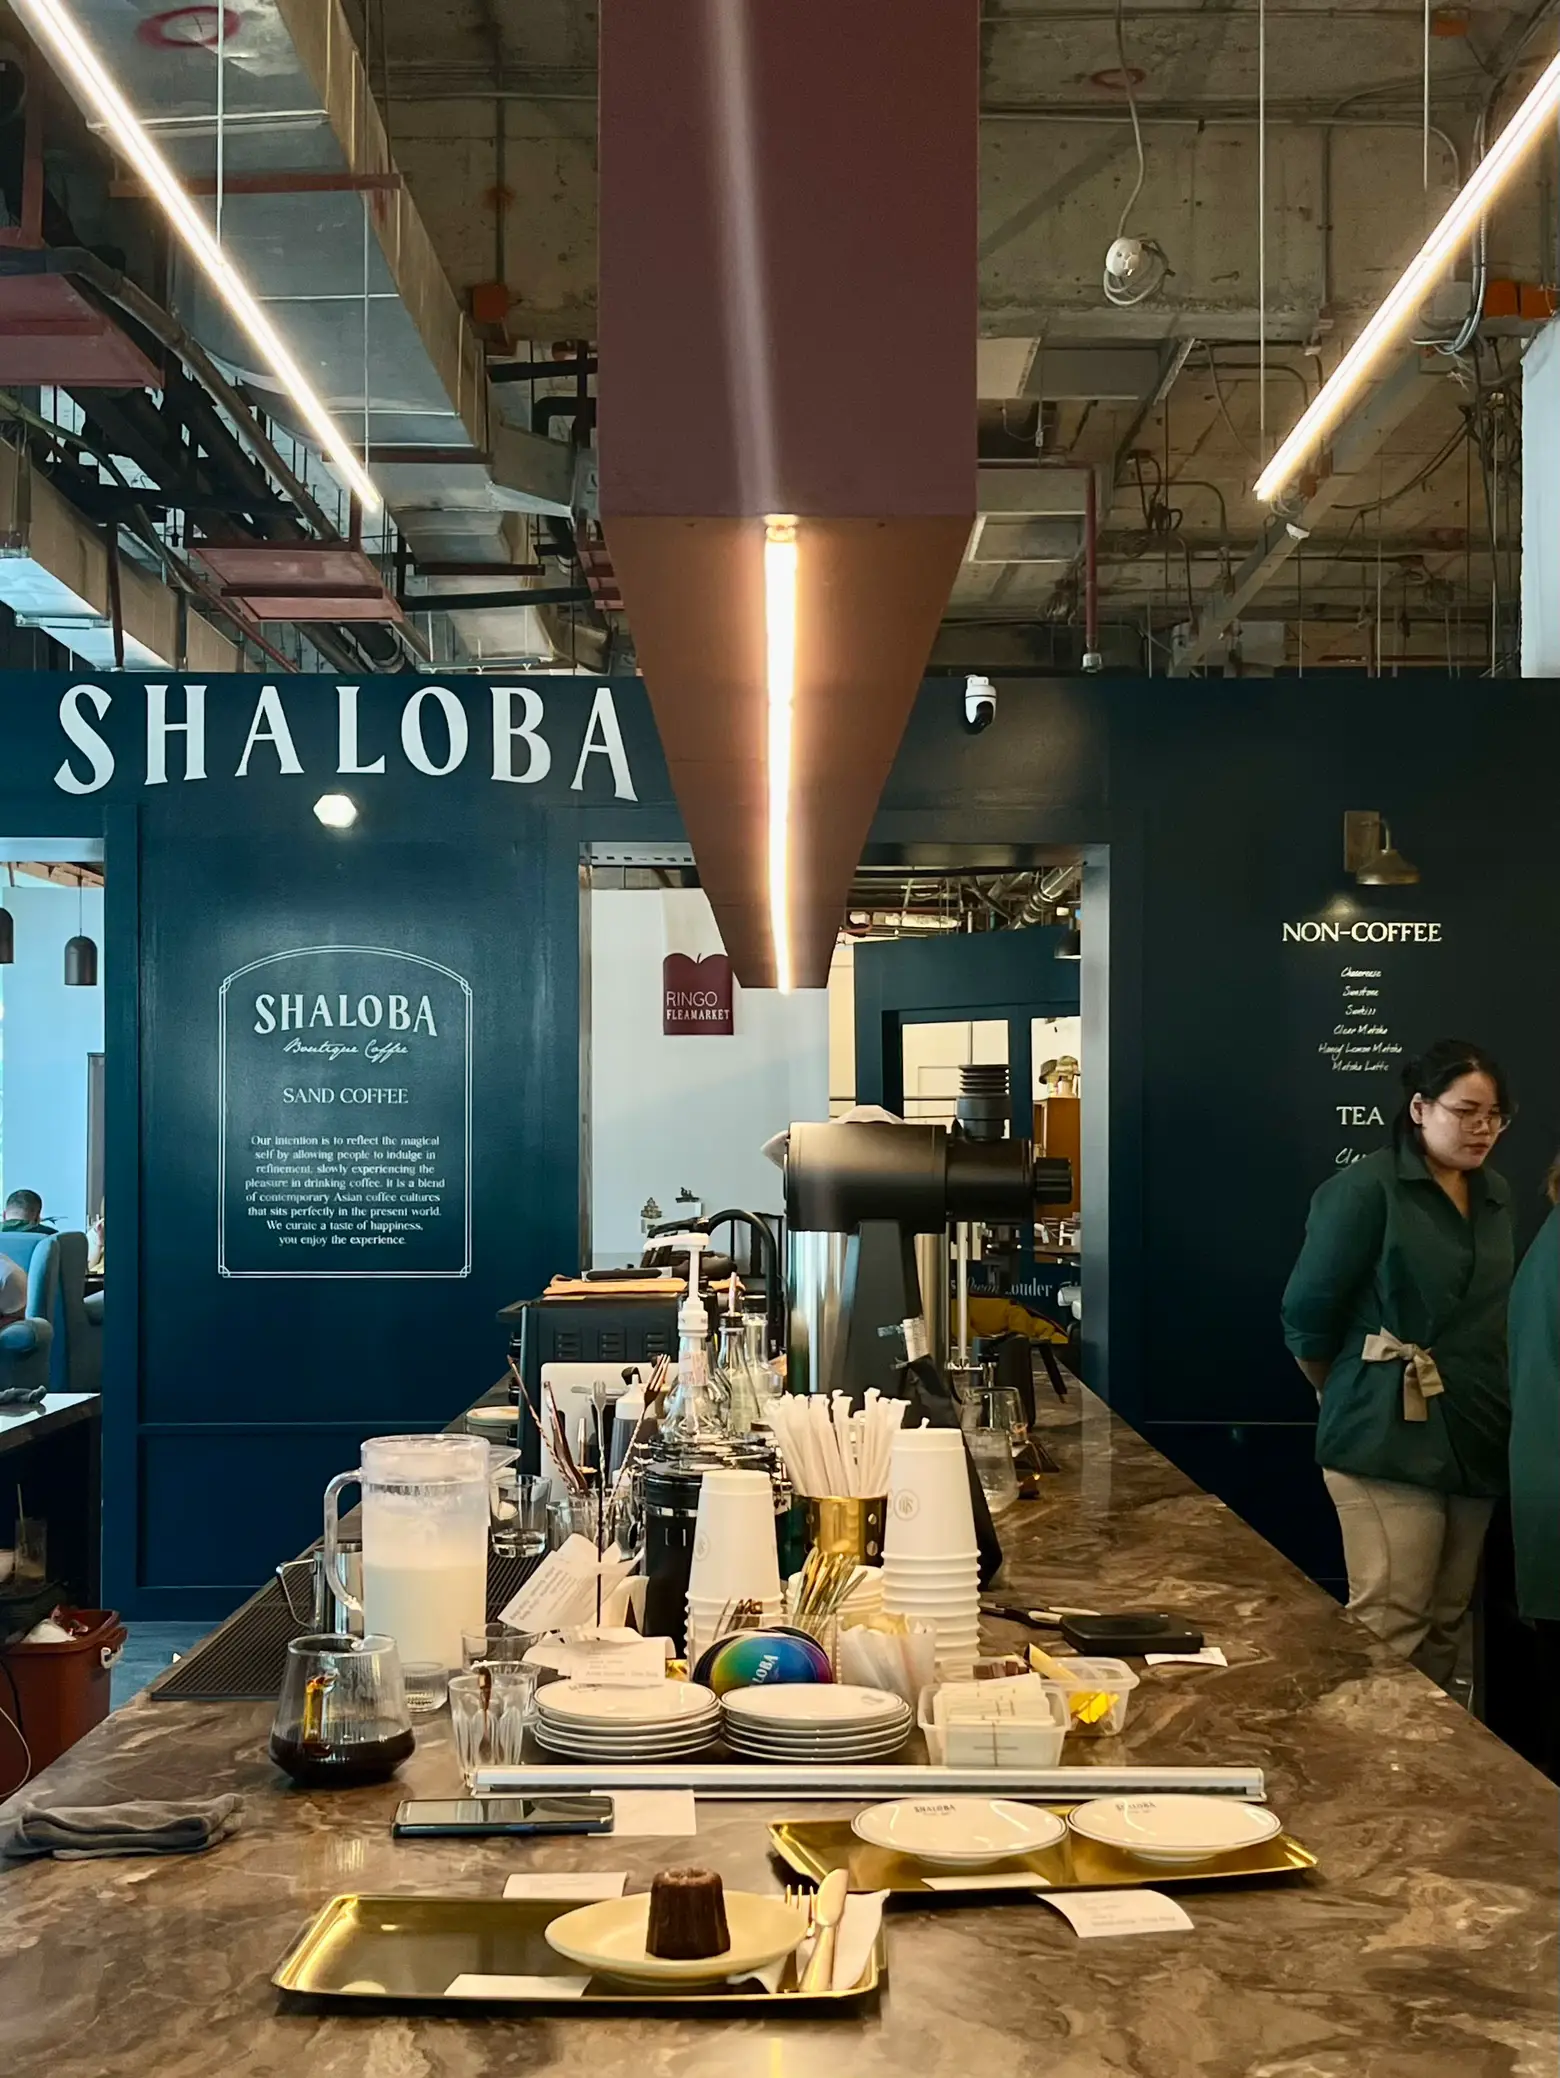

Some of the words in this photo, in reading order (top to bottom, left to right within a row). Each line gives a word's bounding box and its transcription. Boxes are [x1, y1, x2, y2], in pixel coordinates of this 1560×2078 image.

[54, 684, 639, 802] SHALOBA
[1282, 922, 1442, 942] NON-COFFEE
[666, 991, 718, 1006] RINGO
[254, 994, 438, 1037] SHALOBA
[666, 1009, 730, 1020] FLEAMARKET
[1334, 1025, 1356, 1034] Clear
[1358, 1024, 1387, 1034] Matcha
[284, 1037, 357, 1061] Boutique
[365, 1039, 408, 1063] Coffee
[1345, 1042, 1370, 1053] Lemon
[1373, 1043, 1402, 1053] Matcha
[1332, 1062, 1362, 1071] Matcha
[1364, 1061, 1389, 1071] Latte
[283, 1088, 334, 1104] SAND
[340, 1088, 408, 1104] COFFEE
[1336, 1106, 1384, 1125] TEA
[251, 1136, 271, 1145] Our
[275, 1136, 318, 1145] intention
[322, 1137, 330, 1145] is
[347, 1135, 378, 1145] reflect
[382, 1136, 396, 1145] the
[401, 1136, 439, 1148] magical
[255, 1149, 275, 1159] self
[277, 1150, 289, 1162] by
[293, 1150, 333, 1162] allowing
[338, 1150, 369, 1161] people
[374, 1151, 383, 1159] to
[387, 1150, 422, 1162] indulge
[426, 1151, 435, 1159] in
[317, 1164, 348, 1175] slowly
[352, 1165, 415, 1176] experiencing
[419, 1164, 434, 1173] the
[246, 1178, 288, 1190] pleasure
[292, 1179, 301, 1187] in
[304, 1178, 346, 1190] drinking
[397, 1179, 405, 1187] is
[418, 1178, 445, 1187] blend
[246, 1192, 257, 1201] of
[259, 1194, 330, 1204] contemporary
[334, 1193, 362, 1201] Asian
[366, 1192, 396, 1201] coffee
[400, 1193, 440, 1201] cultures
[248, 1207, 266, 1215] that
[270, 1207, 287, 1215] sits
[291, 1206, 334, 1218] perfectly
[339, 1207, 348, 1216] in
[352, 1207, 366, 1216] the
[371, 1208, 407, 1218] present
[412, 1207, 441, 1216] world.
[267, 1220, 282, 1229] We
[286, 1222, 317, 1230] curate
[330, 1222, 353, 1230] taste
[357, 1220, 368, 1230] of
[279, 1237, 297, 1246] you
[300, 1235, 327, 1246] enjoy
[332, 1235, 346, 1244] the
